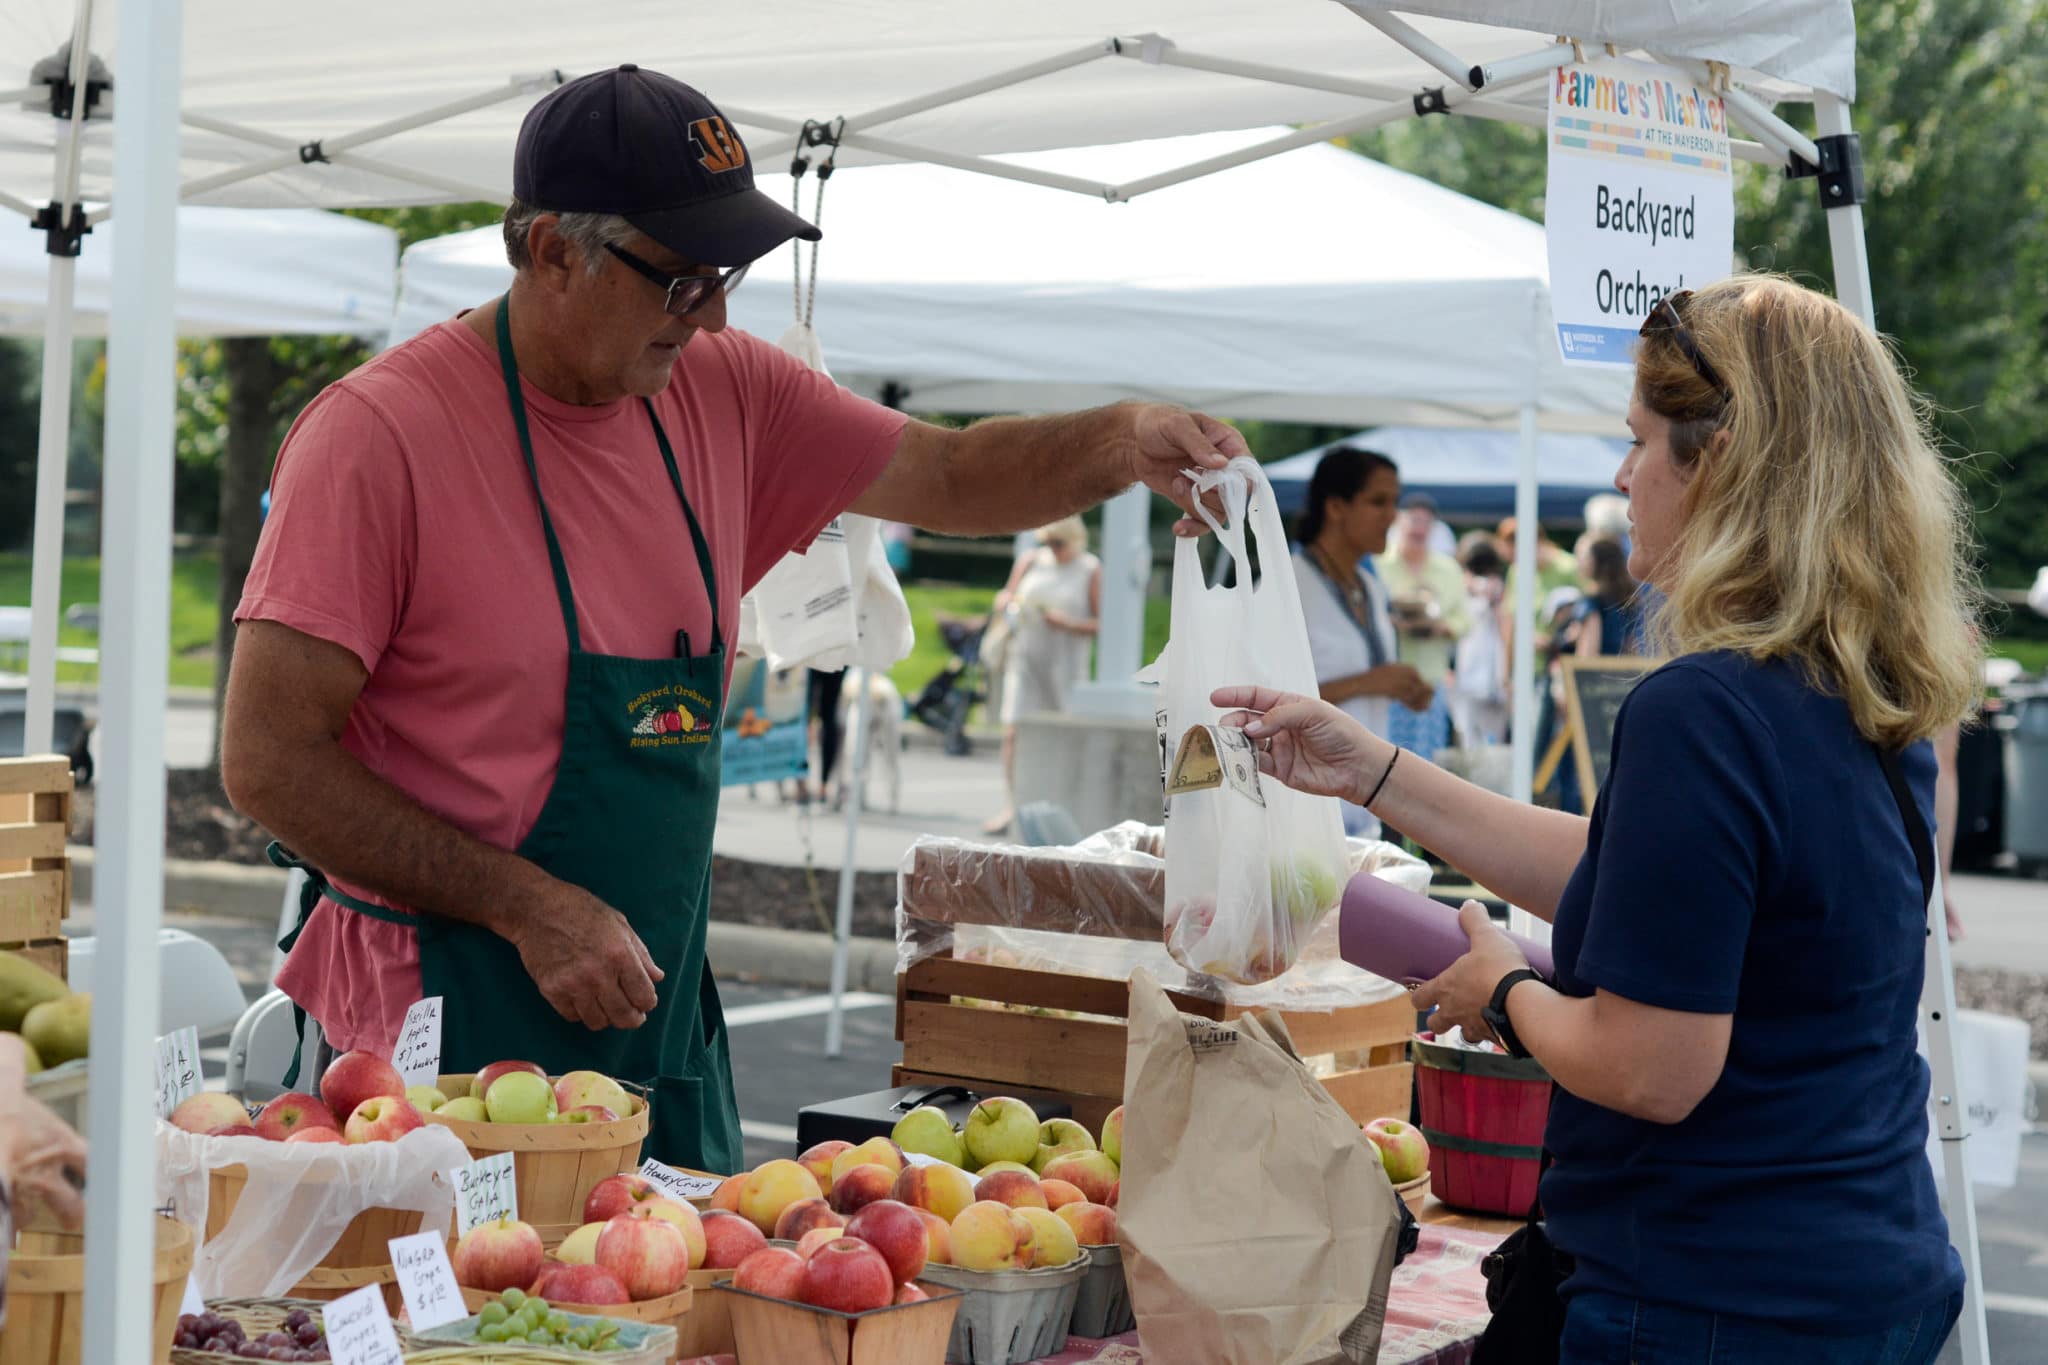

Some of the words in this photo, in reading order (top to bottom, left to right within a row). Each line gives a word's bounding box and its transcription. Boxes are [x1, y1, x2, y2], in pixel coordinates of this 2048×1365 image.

[1556, 65, 1652, 120] Farmers'
[1653, 80, 1726, 134] Market
[1645, 129, 1656, 141] AT
[1657, 130, 1673, 145] THE
[1674, 134, 1714, 153] MAYERSON
[1596, 184, 1695, 247] Backyard
[1596, 269, 1684, 316] Orcha
[661, 735, 679, 745] Sun
[459, 1165, 513, 1193] Buckeye
